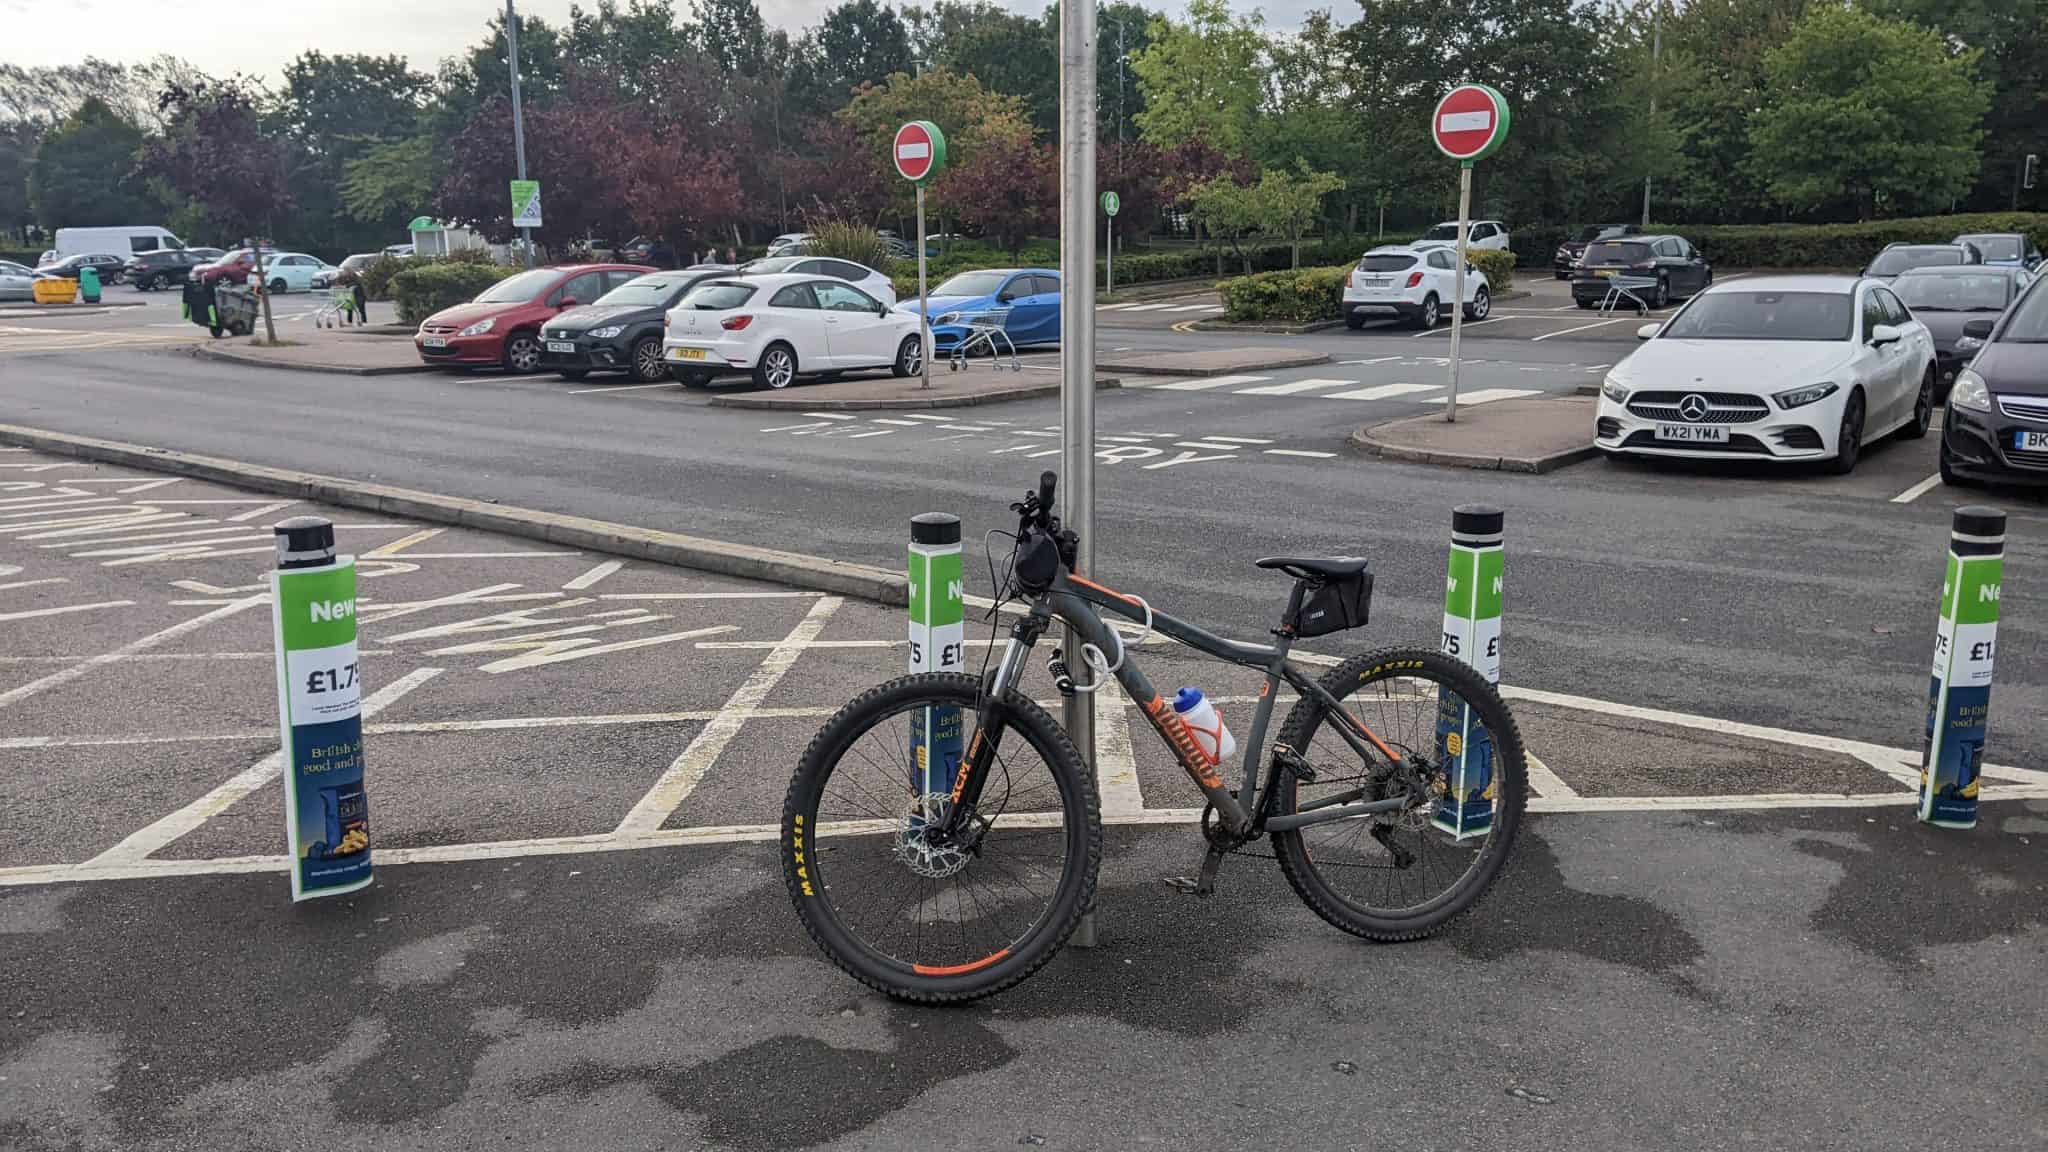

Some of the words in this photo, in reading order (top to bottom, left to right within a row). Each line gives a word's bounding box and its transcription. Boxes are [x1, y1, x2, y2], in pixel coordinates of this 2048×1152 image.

[1663, 425, 1690, 440] WX21
[1695, 428, 1720, 441] YMA
[794, 815, 814, 896] MAXXIS
